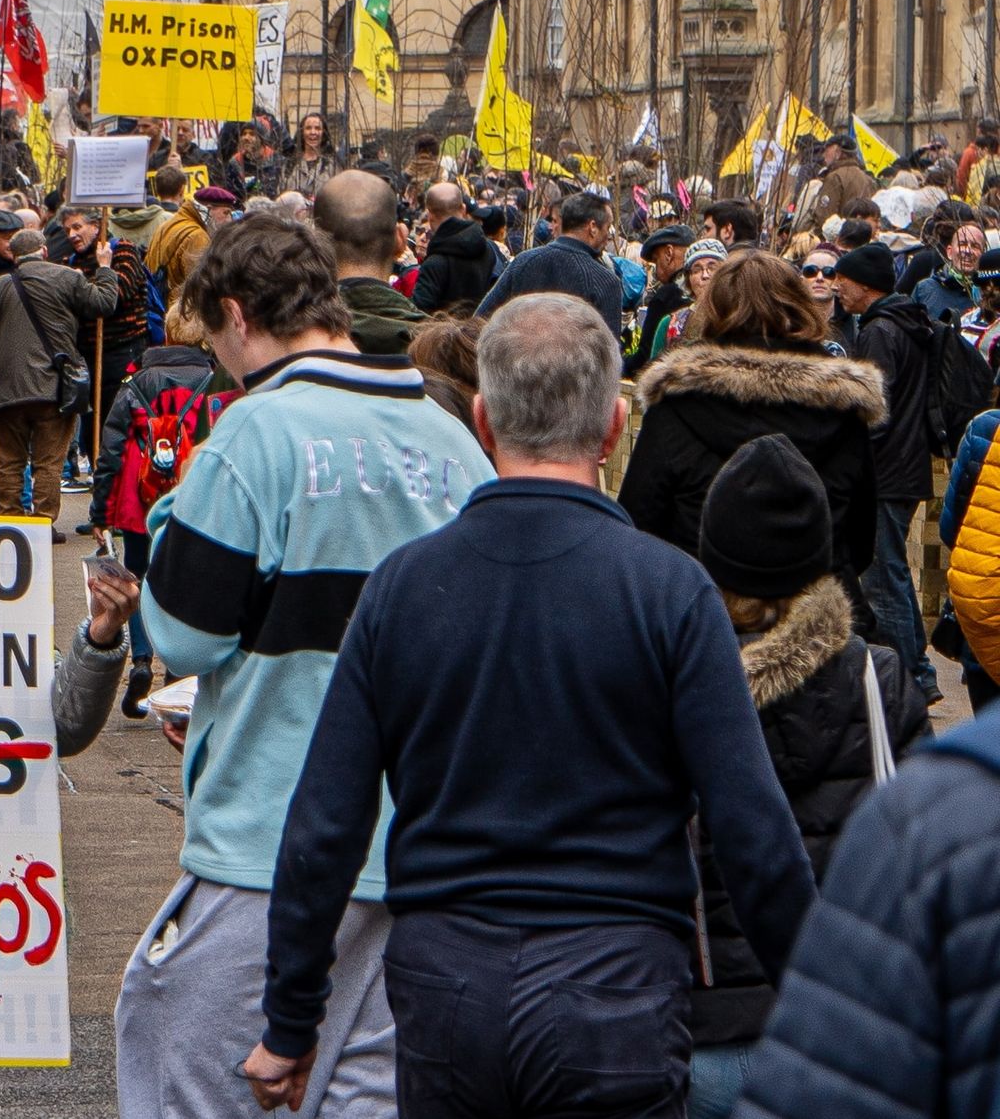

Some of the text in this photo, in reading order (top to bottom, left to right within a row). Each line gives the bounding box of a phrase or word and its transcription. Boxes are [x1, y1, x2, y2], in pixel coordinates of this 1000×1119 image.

[109, 13, 236, 40] H.M. Prison
[121, 45, 236, 71] OXFORD
